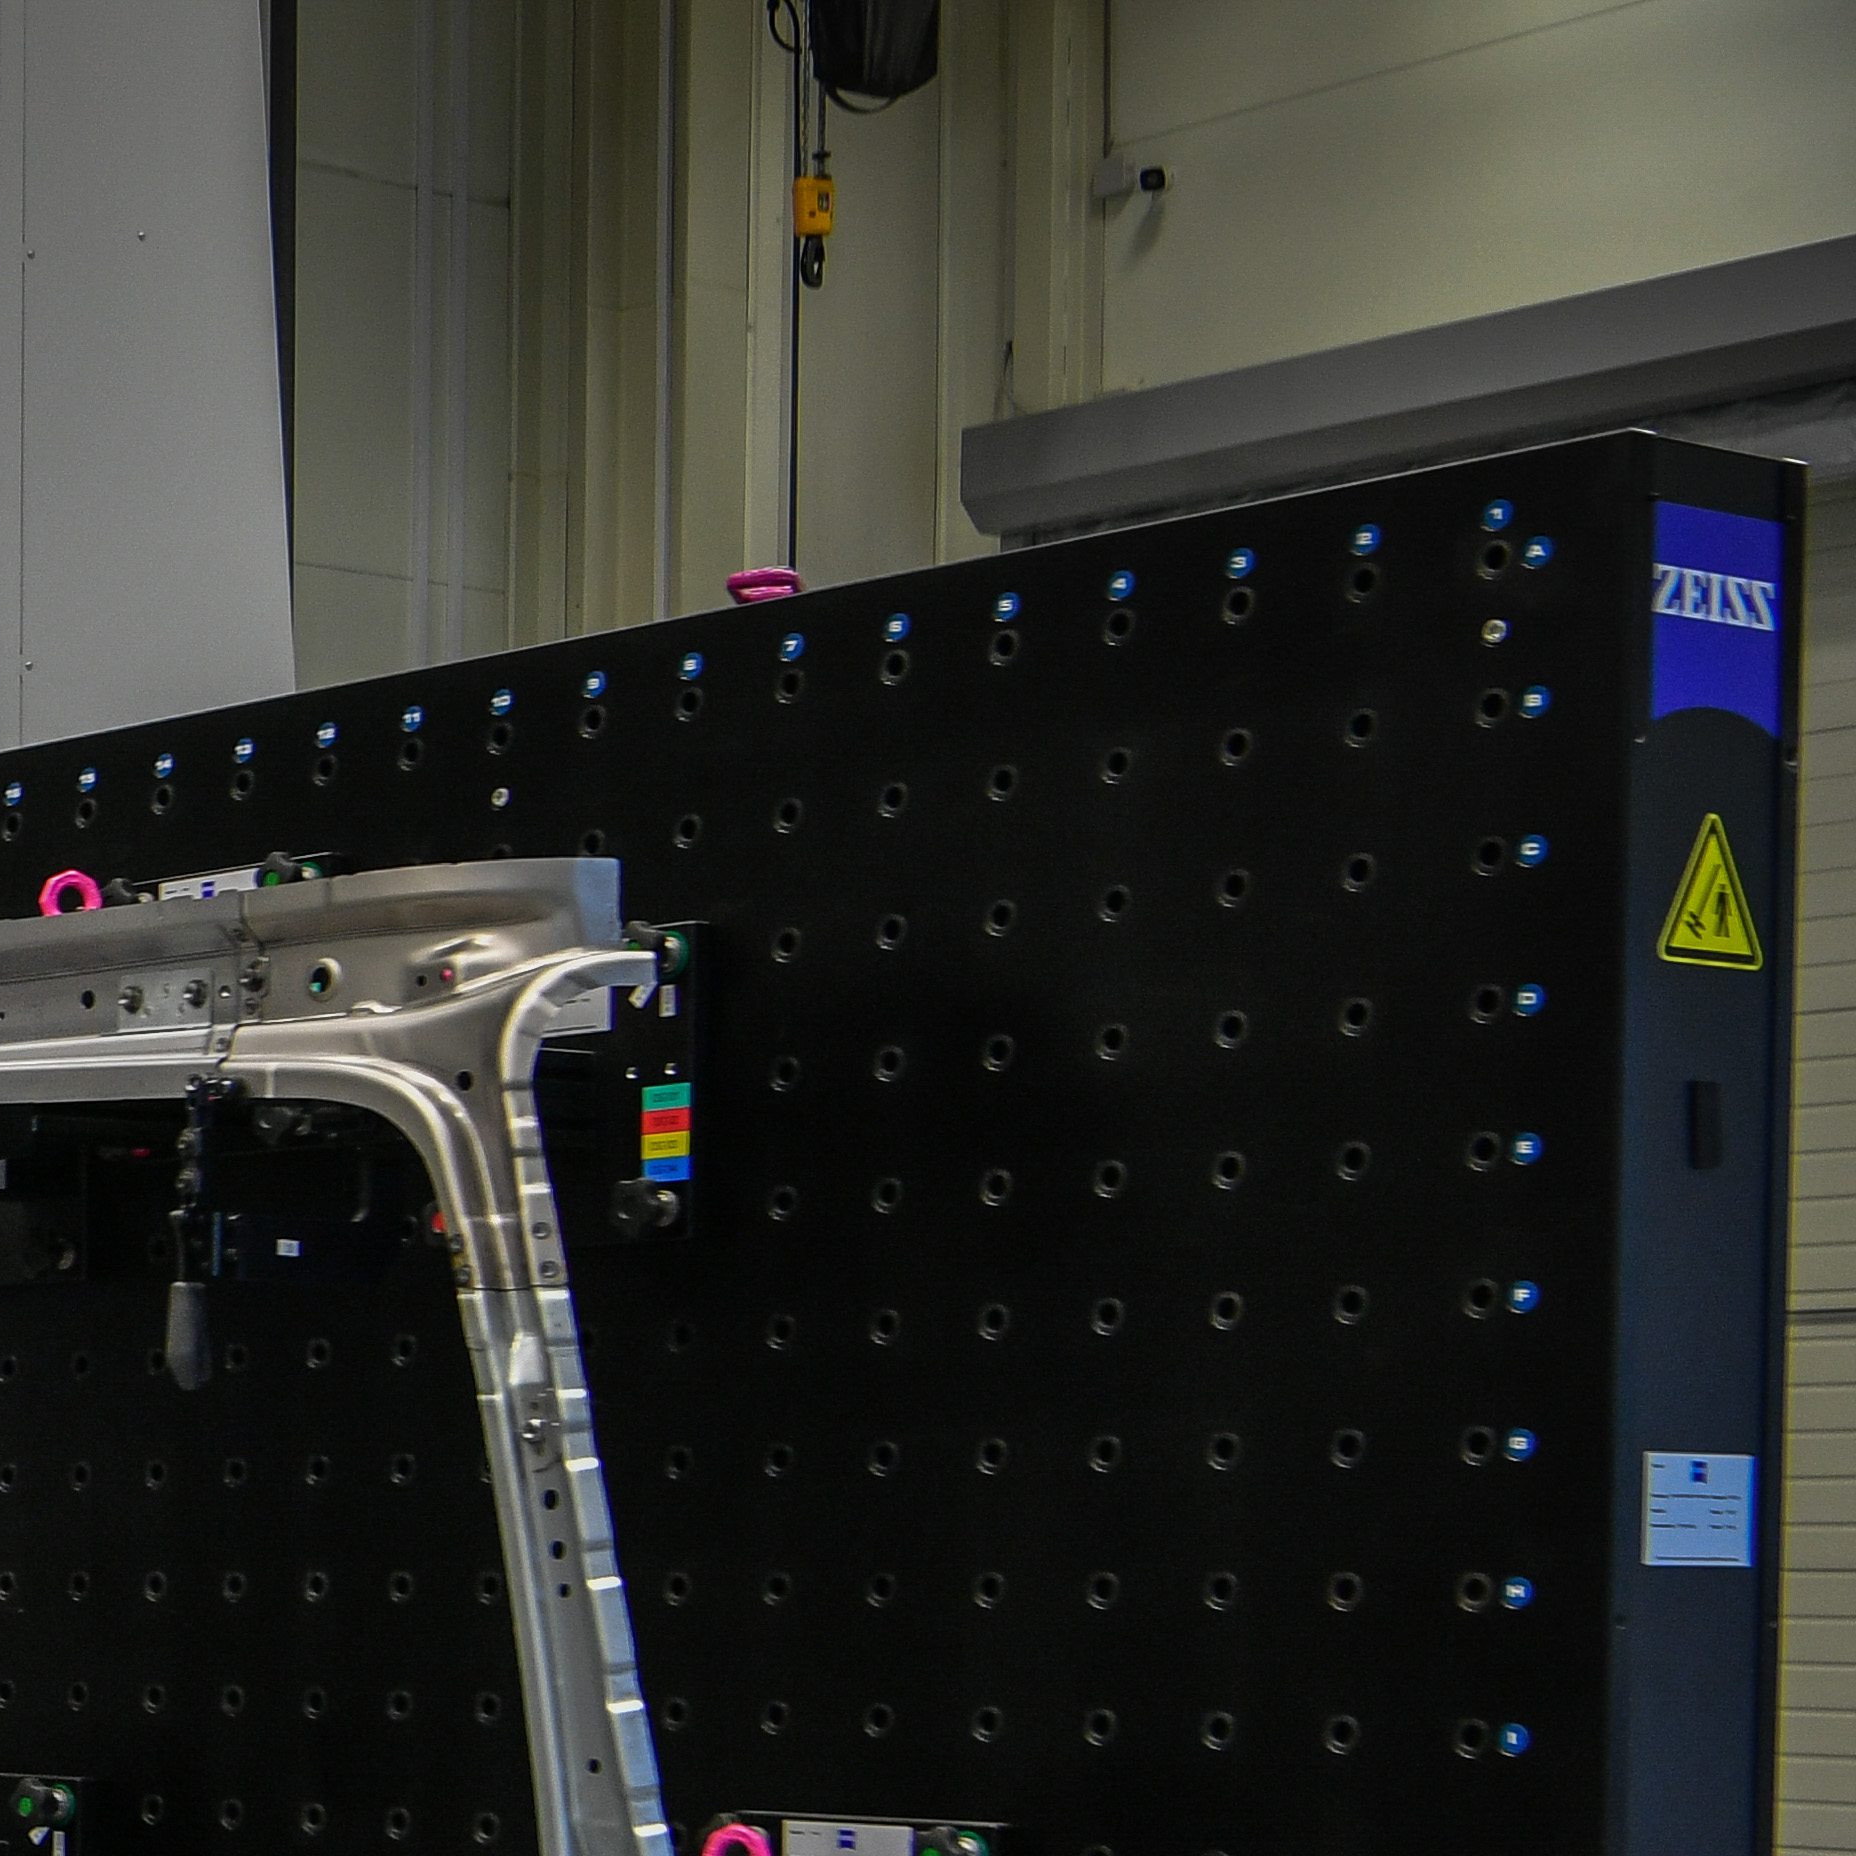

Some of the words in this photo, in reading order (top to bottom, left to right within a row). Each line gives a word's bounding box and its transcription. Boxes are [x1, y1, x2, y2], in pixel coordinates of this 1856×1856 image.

[1525, 544, 1546, 558] A
[1651, 562, 1778, 633] ZEISS
[1523, 693, 1543, 708] B
[1520, 842, 1540, 856] C
[1517, 991, 1537, 1005] D
[1515, 1140, 1534, 1155] E
[1513, 1288, 1531, 1302] F
[1506, 1730, 1518, 1745] I
